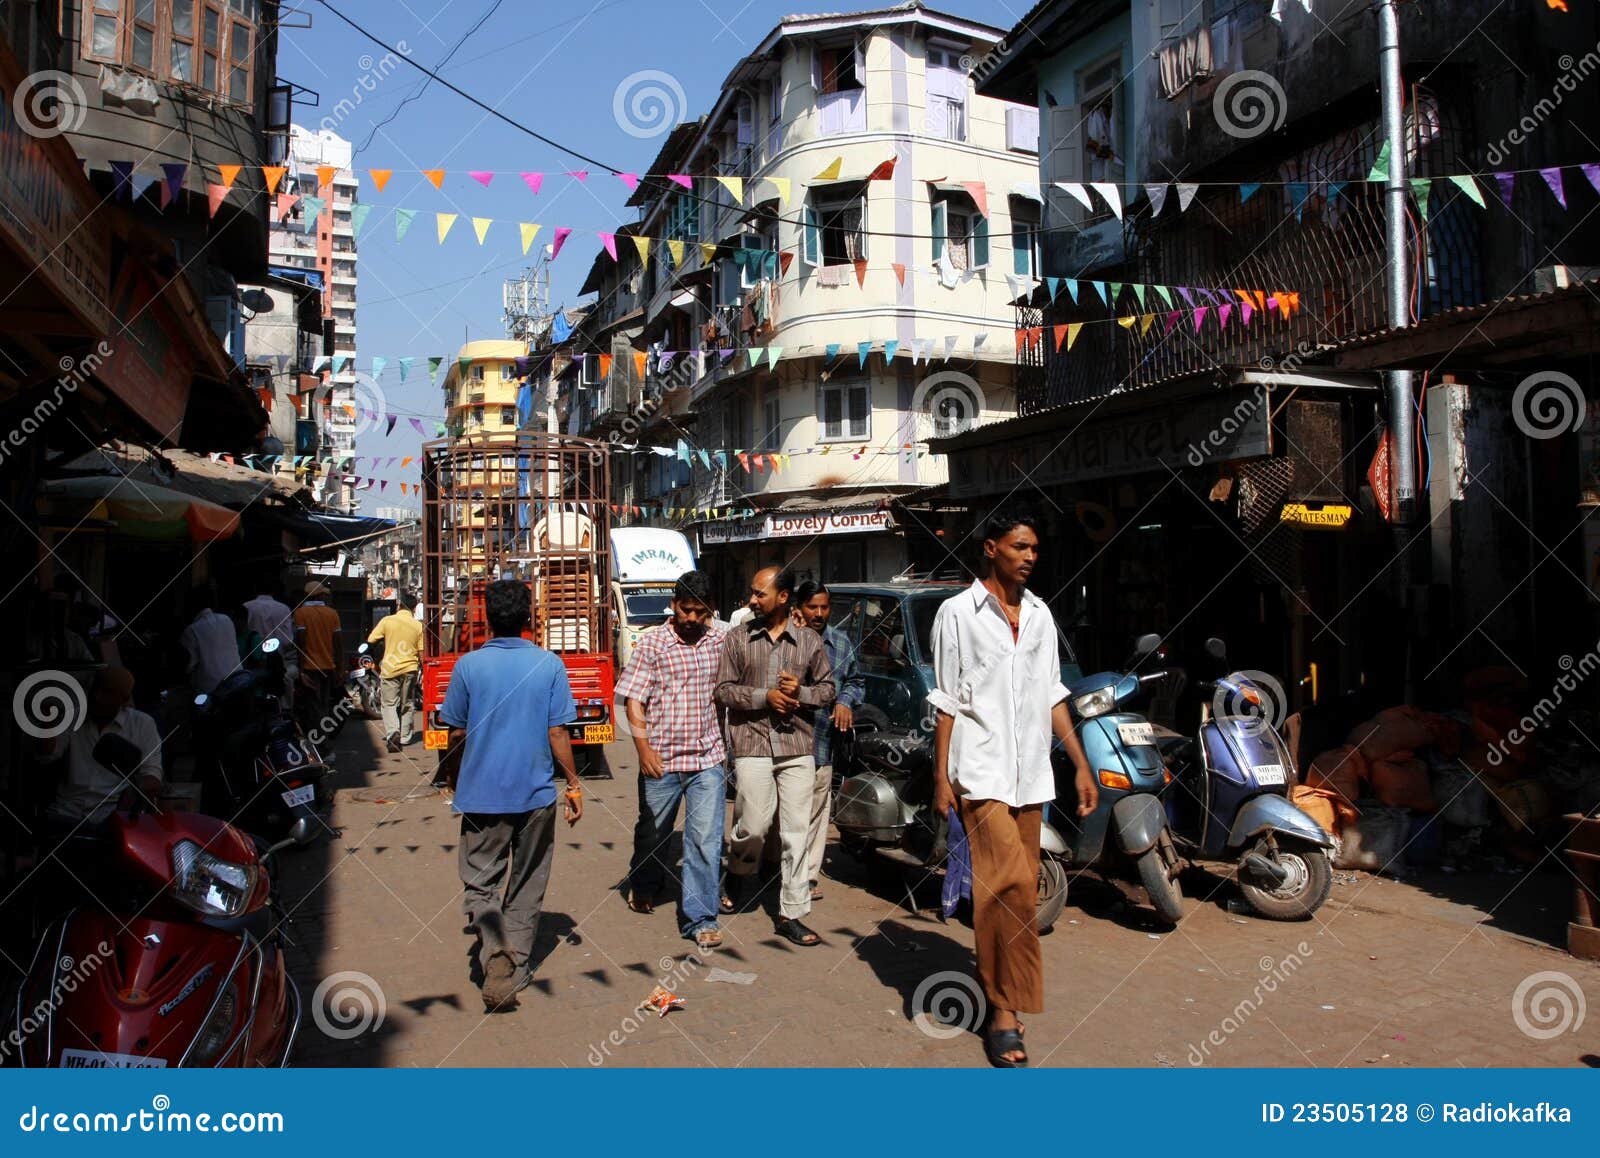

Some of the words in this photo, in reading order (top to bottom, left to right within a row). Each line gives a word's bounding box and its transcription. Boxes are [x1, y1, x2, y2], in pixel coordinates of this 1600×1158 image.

[705, 524, 733, 542] Lovely
[734, 521, 765, 537] Corner
[772, 513, 827, 533] Lovely
[831, 511, 886, 528] Corner
[631, 549, 678, 565] IMRAN
